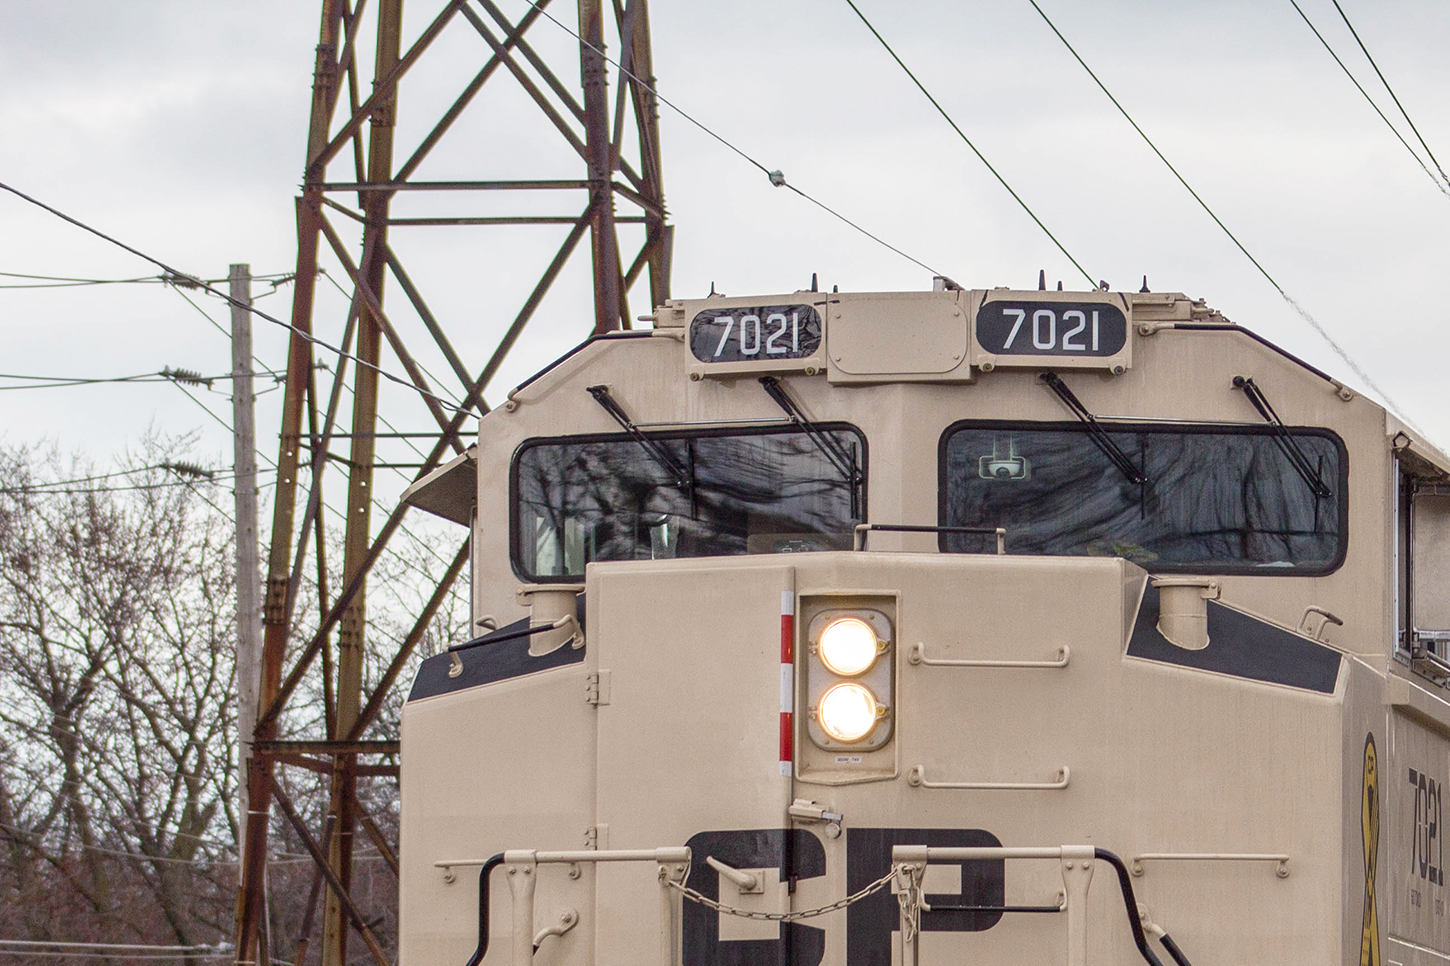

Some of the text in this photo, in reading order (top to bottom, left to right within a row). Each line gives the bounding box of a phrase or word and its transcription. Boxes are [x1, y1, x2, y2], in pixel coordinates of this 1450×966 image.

[714, 312, 798, 357] 7021
[1003, 308, 1099, 351] 7021
[1409, 767, 1443, 887] 7021
